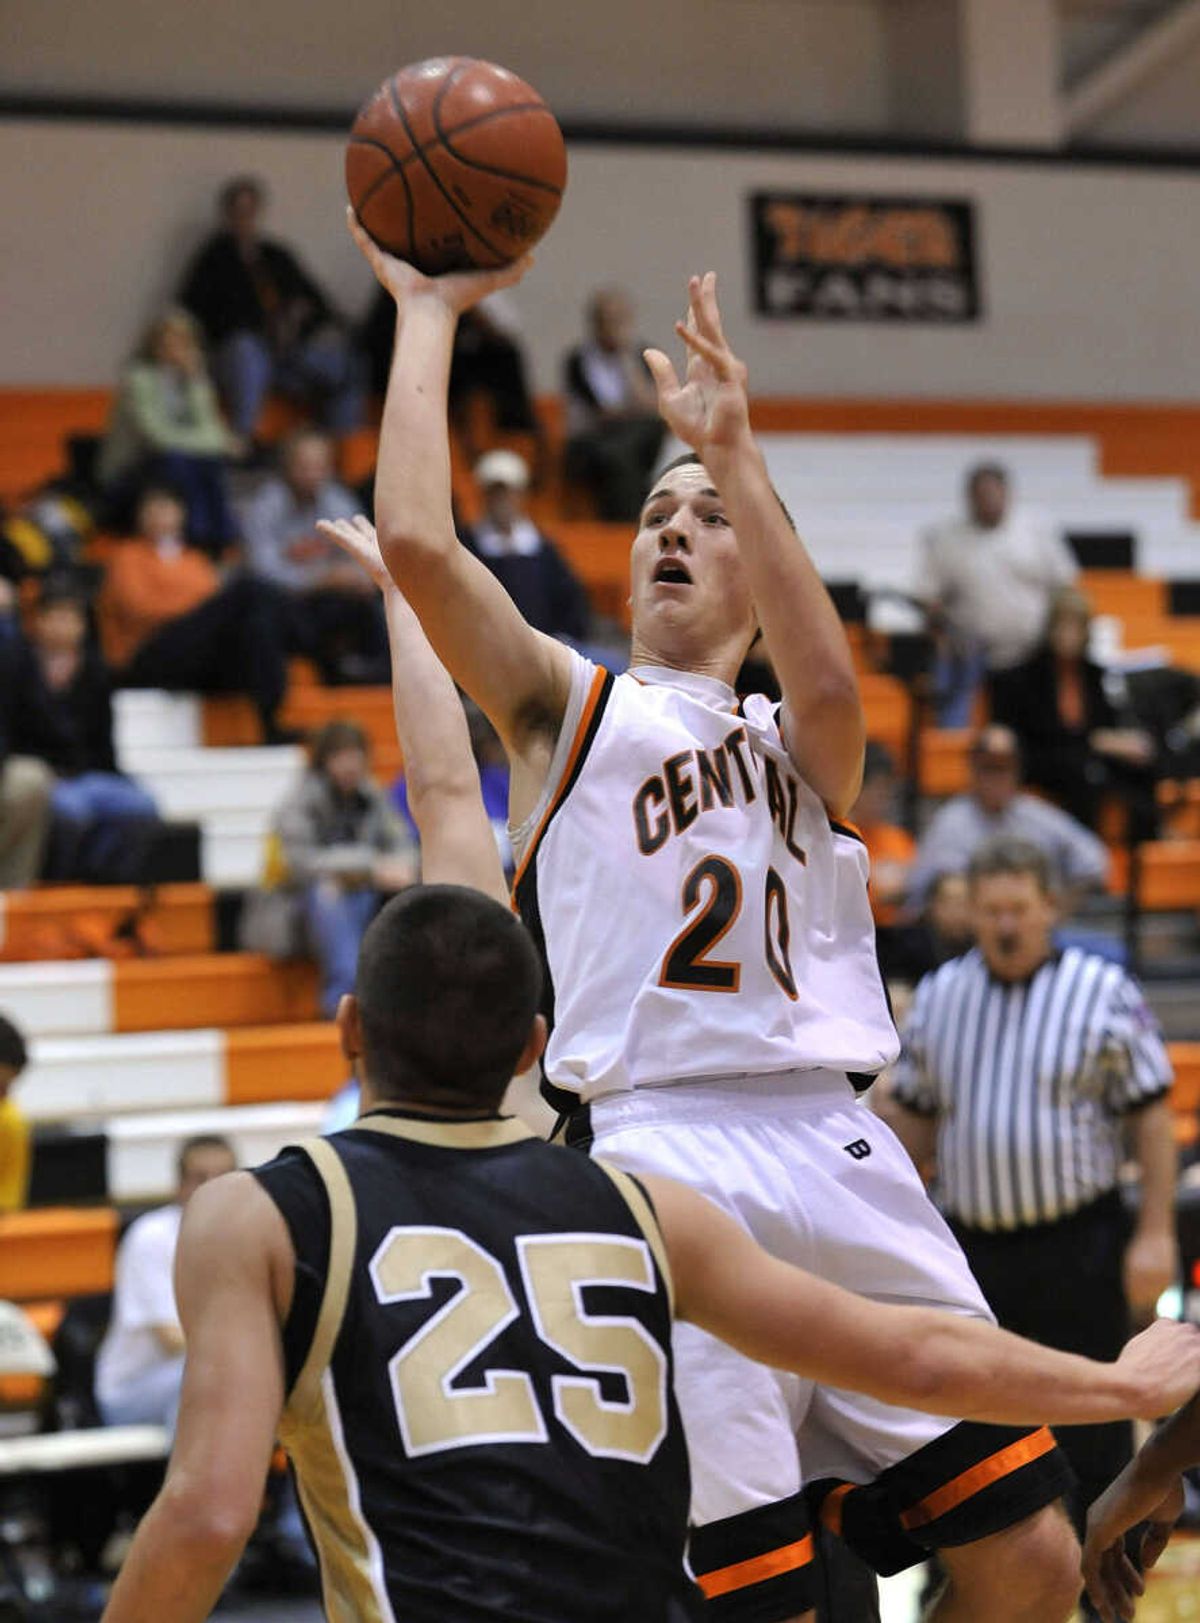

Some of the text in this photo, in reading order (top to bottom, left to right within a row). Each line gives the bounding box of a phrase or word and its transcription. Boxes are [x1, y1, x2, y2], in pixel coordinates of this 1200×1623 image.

[632, 726, 808, 867] CENTAL
[657, 854, 800, 1002] 20
[843, 1138, 872, 1160] B
[368, 1225, 668, 1466] 25
